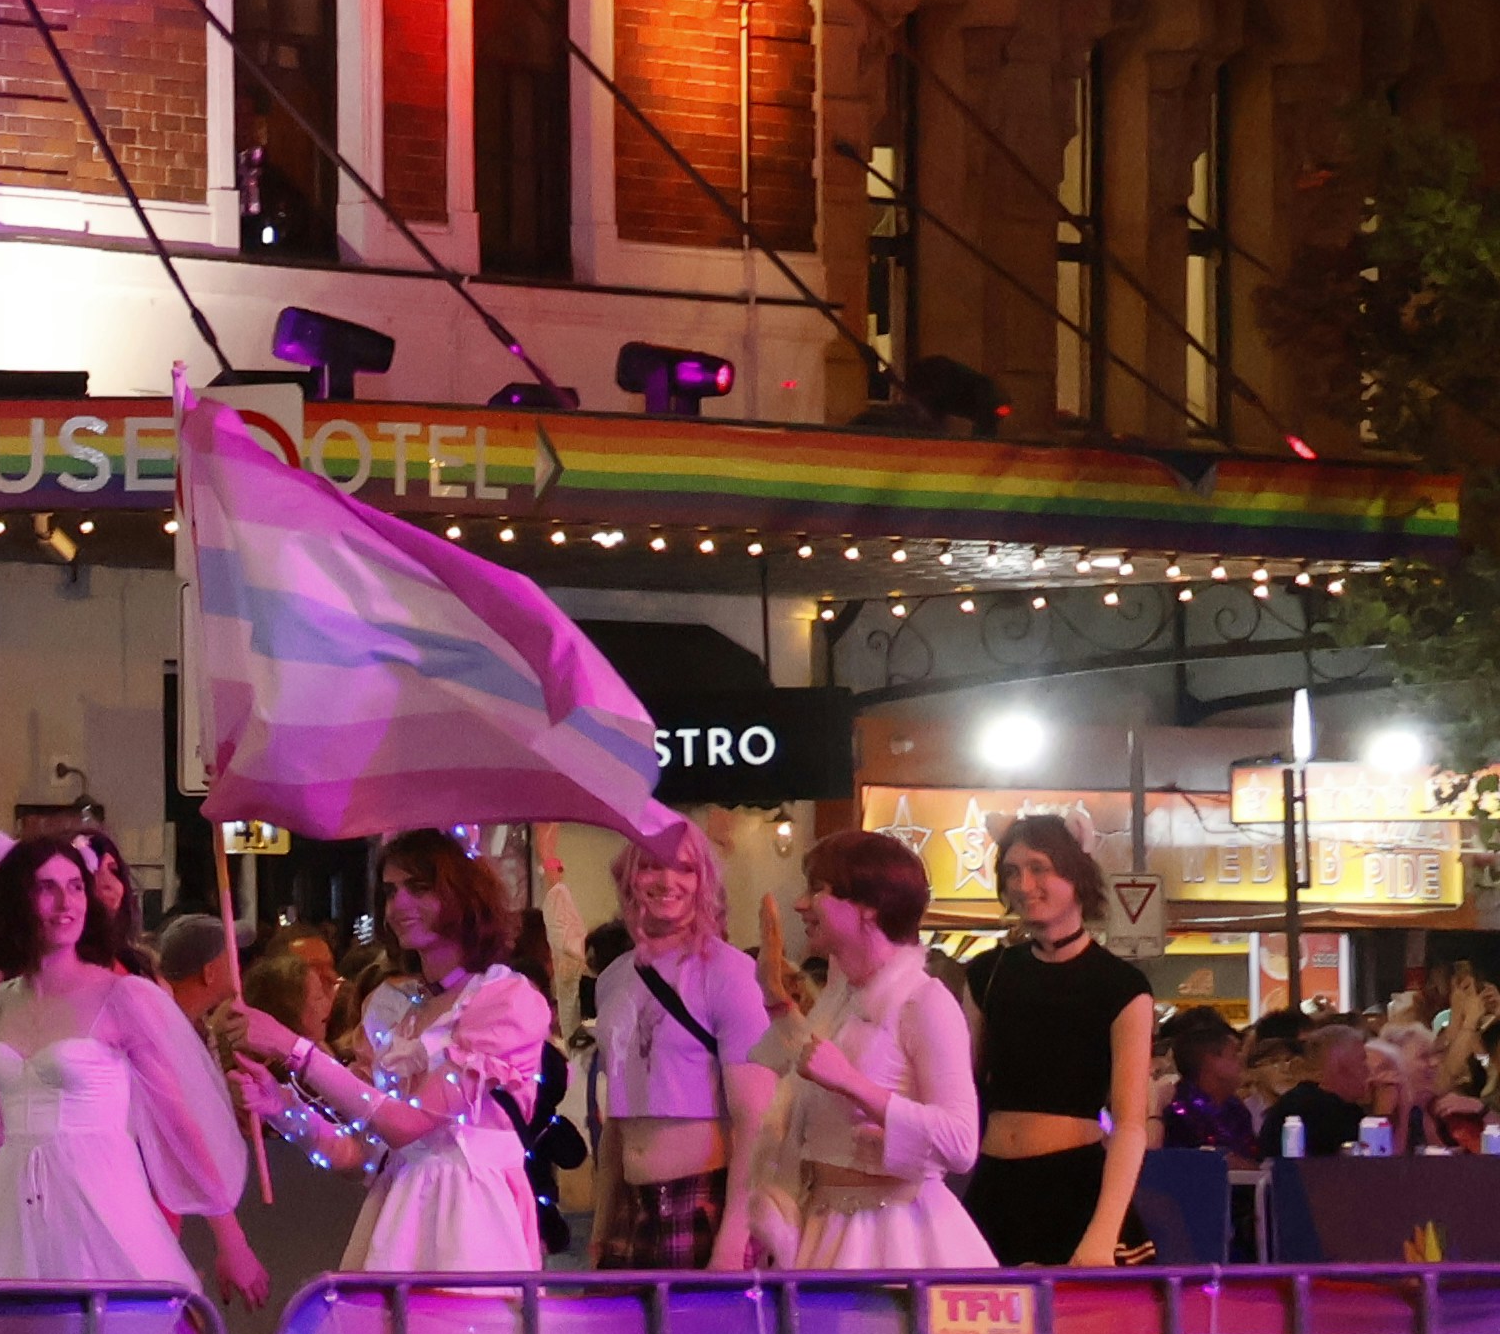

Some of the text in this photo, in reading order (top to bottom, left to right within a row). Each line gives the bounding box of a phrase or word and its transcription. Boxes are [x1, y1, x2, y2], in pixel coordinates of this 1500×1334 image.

[309, 419, 509, 500] OTEL
[653, 724, 777, 767] STRO
[1363, 851, 1441, 901] PIDE
[940, 1289, 1015, 1322] TFH
